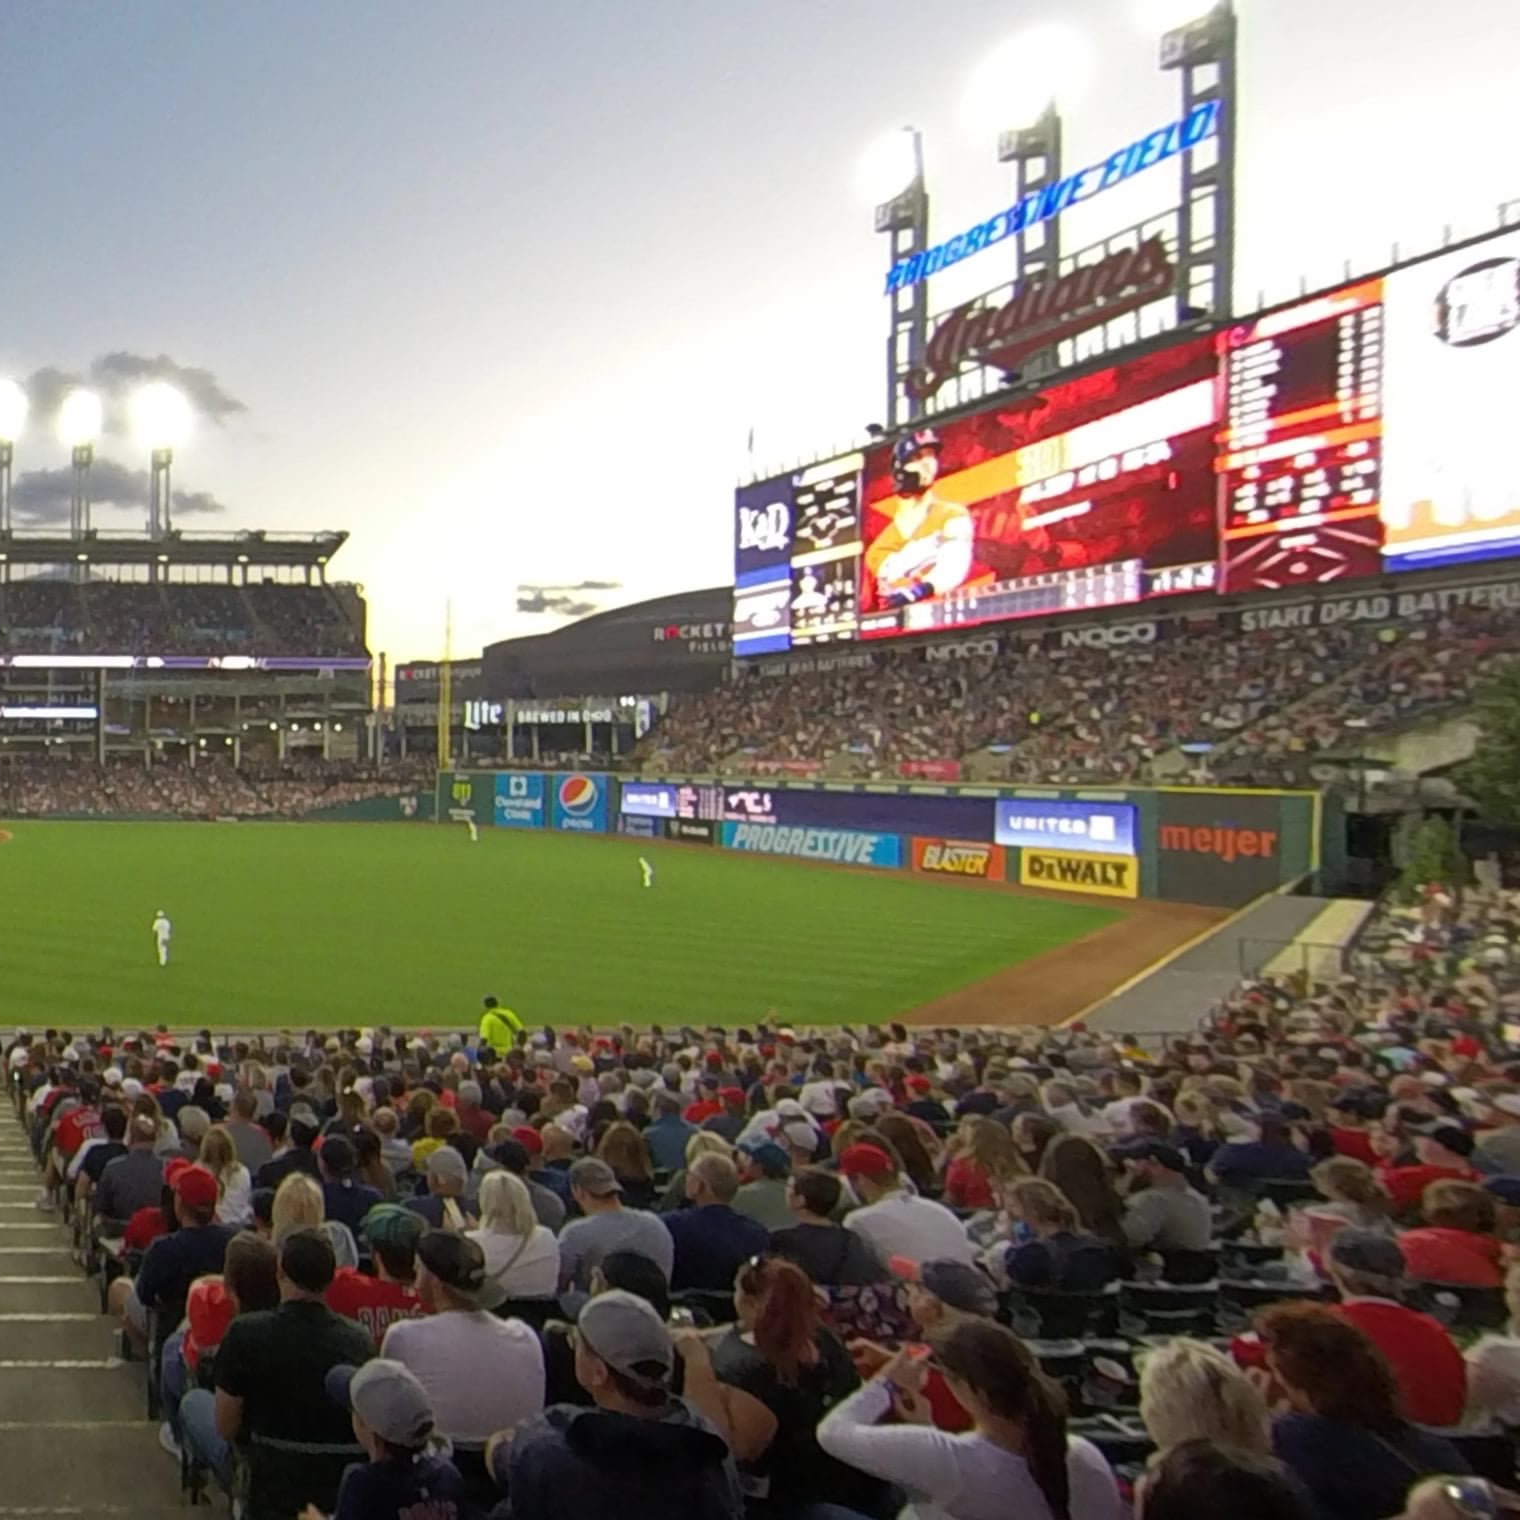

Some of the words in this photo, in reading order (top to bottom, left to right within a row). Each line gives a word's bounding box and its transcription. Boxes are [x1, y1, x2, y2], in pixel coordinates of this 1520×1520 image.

[884, 168, 1092, 296] PROGRESSIVE
[1100, 99, 1223, 192] FIELD
[904, 228, 1175, 399] Indians
[1241, 602, 1314, 631] START
[1319, 596, 1391, 625] DEAD
[653, 622, 725, 641] ROCKET
[1062, 622, 1157, 649] NOCO
[926, 639, 999, 662] NOCO
[465, 699, 503, 730] Lite
[495, 796, 542, 810] Cleveland
[1009, 814, 1088, 835] UNITED
[731, 823, 879, 864] PROGRESSIVE
[1160, 822, 1277, 862] meijer
